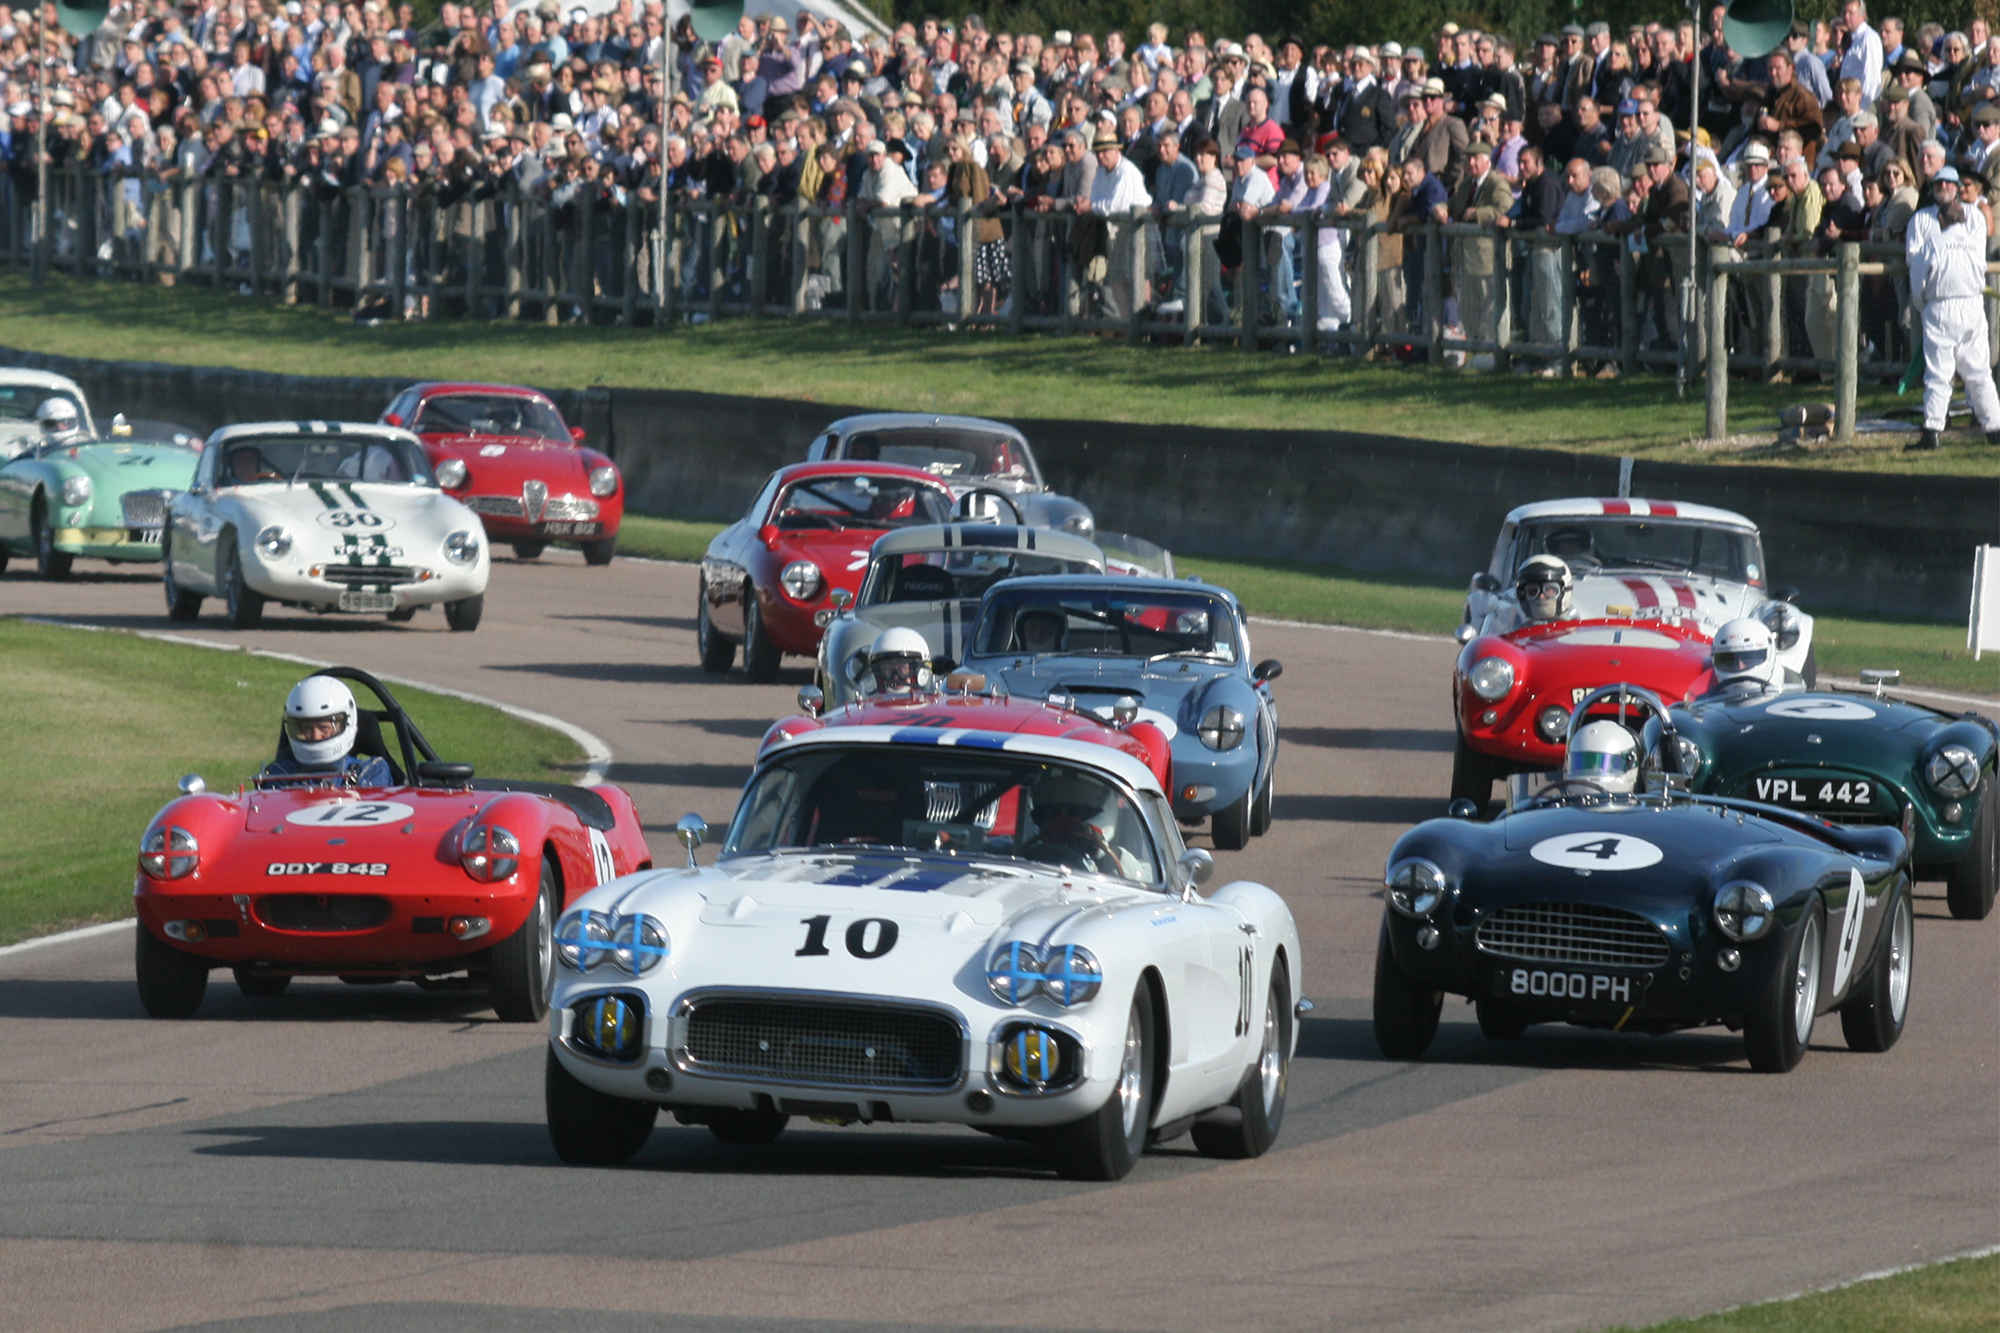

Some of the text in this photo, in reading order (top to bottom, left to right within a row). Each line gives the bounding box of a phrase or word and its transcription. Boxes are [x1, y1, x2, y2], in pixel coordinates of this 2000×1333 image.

[331, 511, 382, 528] 30
[1613, 629, 1623, 644] 1
[1783, 701, 1846, 713] 2
[1756, 777, 1870, 804] VPL 442
[316, 804, 391, 822] 12
[1565, 838, 1621, 860] 4
[267, 862, 388, 877] ODY 842
[794, 914, 900, 960] 10
[1843, 889, 1860, 968] 4
[1234, 945, 1253, 1038] 10
[1510, 968, 1631, 1003] 8000 PH
